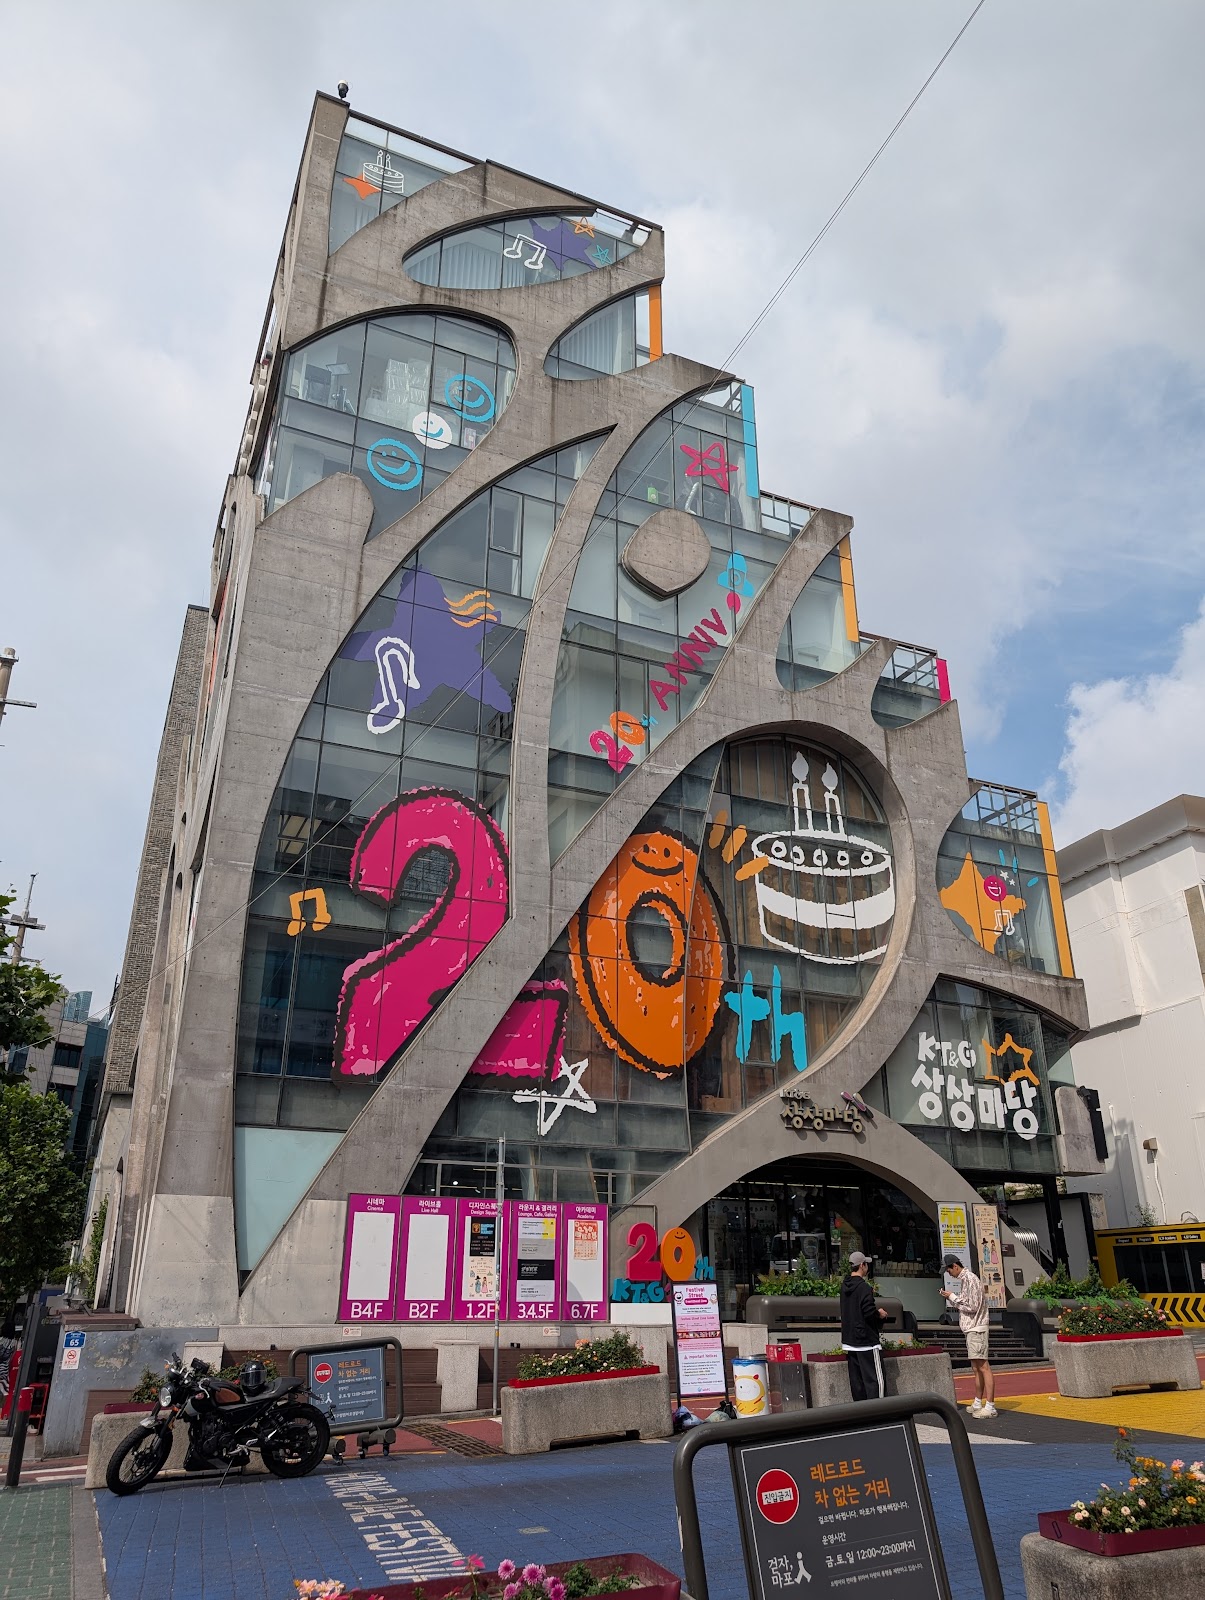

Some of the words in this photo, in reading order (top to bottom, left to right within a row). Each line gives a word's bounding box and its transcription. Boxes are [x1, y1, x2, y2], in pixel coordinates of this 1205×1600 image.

[917, 1031, 977, 1069] KT&G
[910, 1063, 1039, 1140] 상상마당
[780, 1100, 863, 1134] 상상마당
[366, 1197, 386, 1206] 시네마
[418, 1200, 442, 1209] 라이브홀
[518, 1203, 535, 1211] 라운지
[611, 1278, 665, 1303] KT&G
[350, 1302, 383, 1318] B4F
[408, 1302, 439, 1319] B2F
[517, 1303, 554, 1319] 3.4.5F
[571, 1303, 599, 1319] 6.7F
[69, 1338, 80, 1346] 65
[809, 1458, 866, 1484] 레드로드
[764, 1489, 792, 1504] 진입금지
[814, 1488, 829, 1509] 차
[832, 1484, 861, 1508] 없는
[864, 1477, 891, 1500] 거리
[818, 1513, 835, 1525] 걸으면
[859, 1507, 876, 1517] 마포가
[821, 1531, 847, 1545] 운영시간
[767, 1554, 793, 1575] 걷자,
[771, 1571, 795, 1589] 마포
